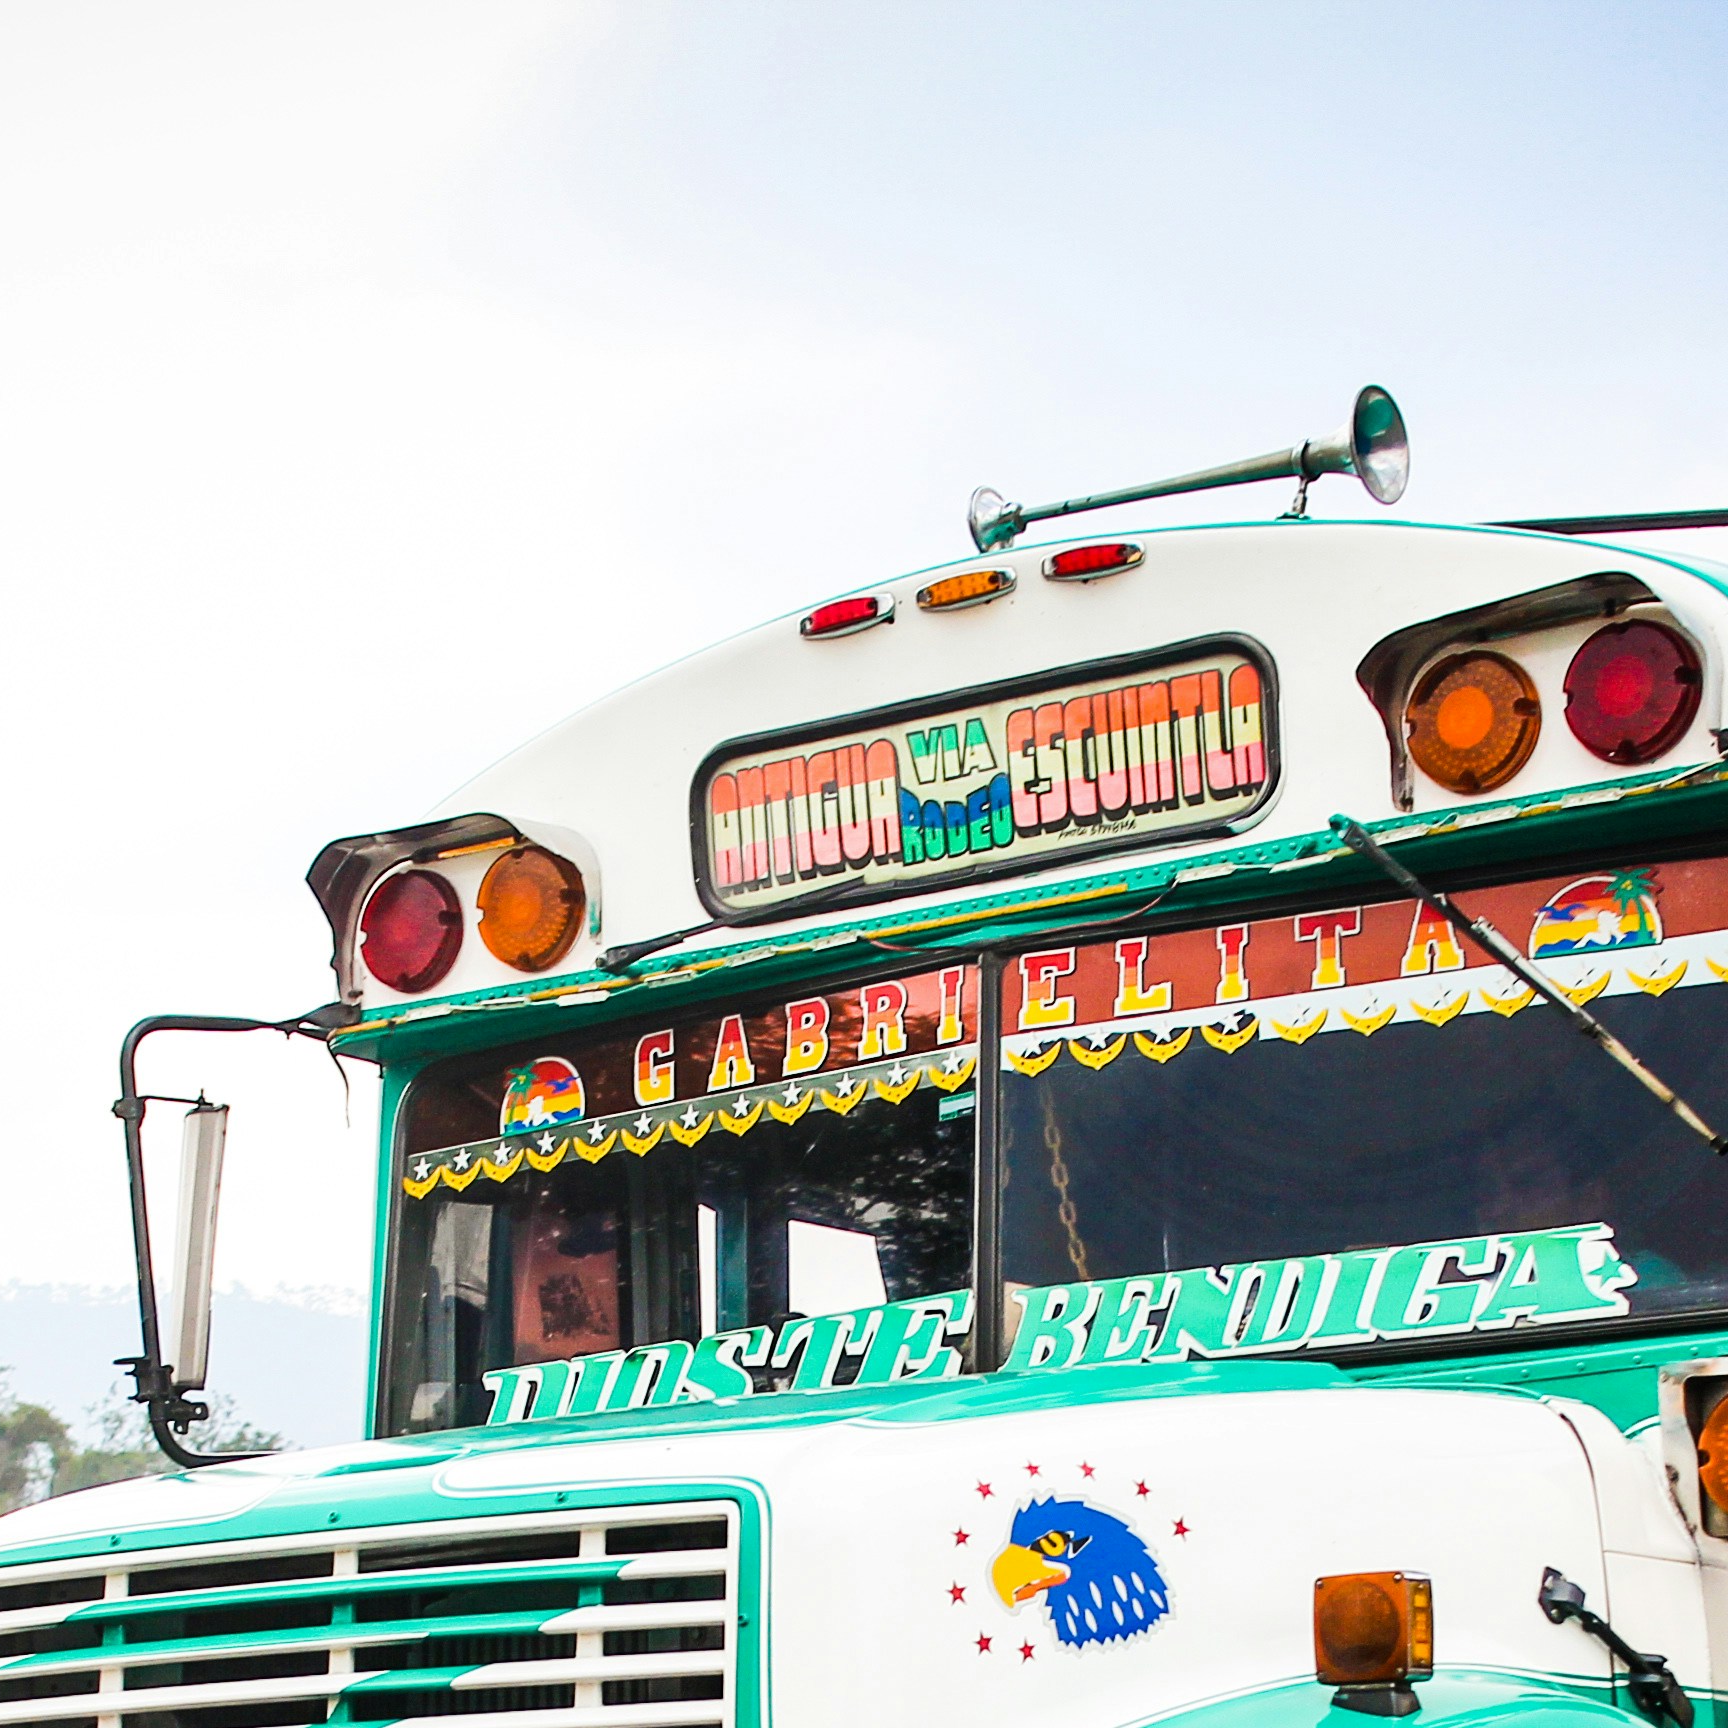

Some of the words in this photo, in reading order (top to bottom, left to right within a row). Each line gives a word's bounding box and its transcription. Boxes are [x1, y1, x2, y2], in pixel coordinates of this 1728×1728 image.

[712, 739, 902, 894] ANTIGUA
[900, 773, 1011, 866] RODEO
[906, 717, 995, 784] VIA
[1006, 663, 1268, 837] ESCUINTLA
[998, 1221, 1634, 1374] BENDIGA
